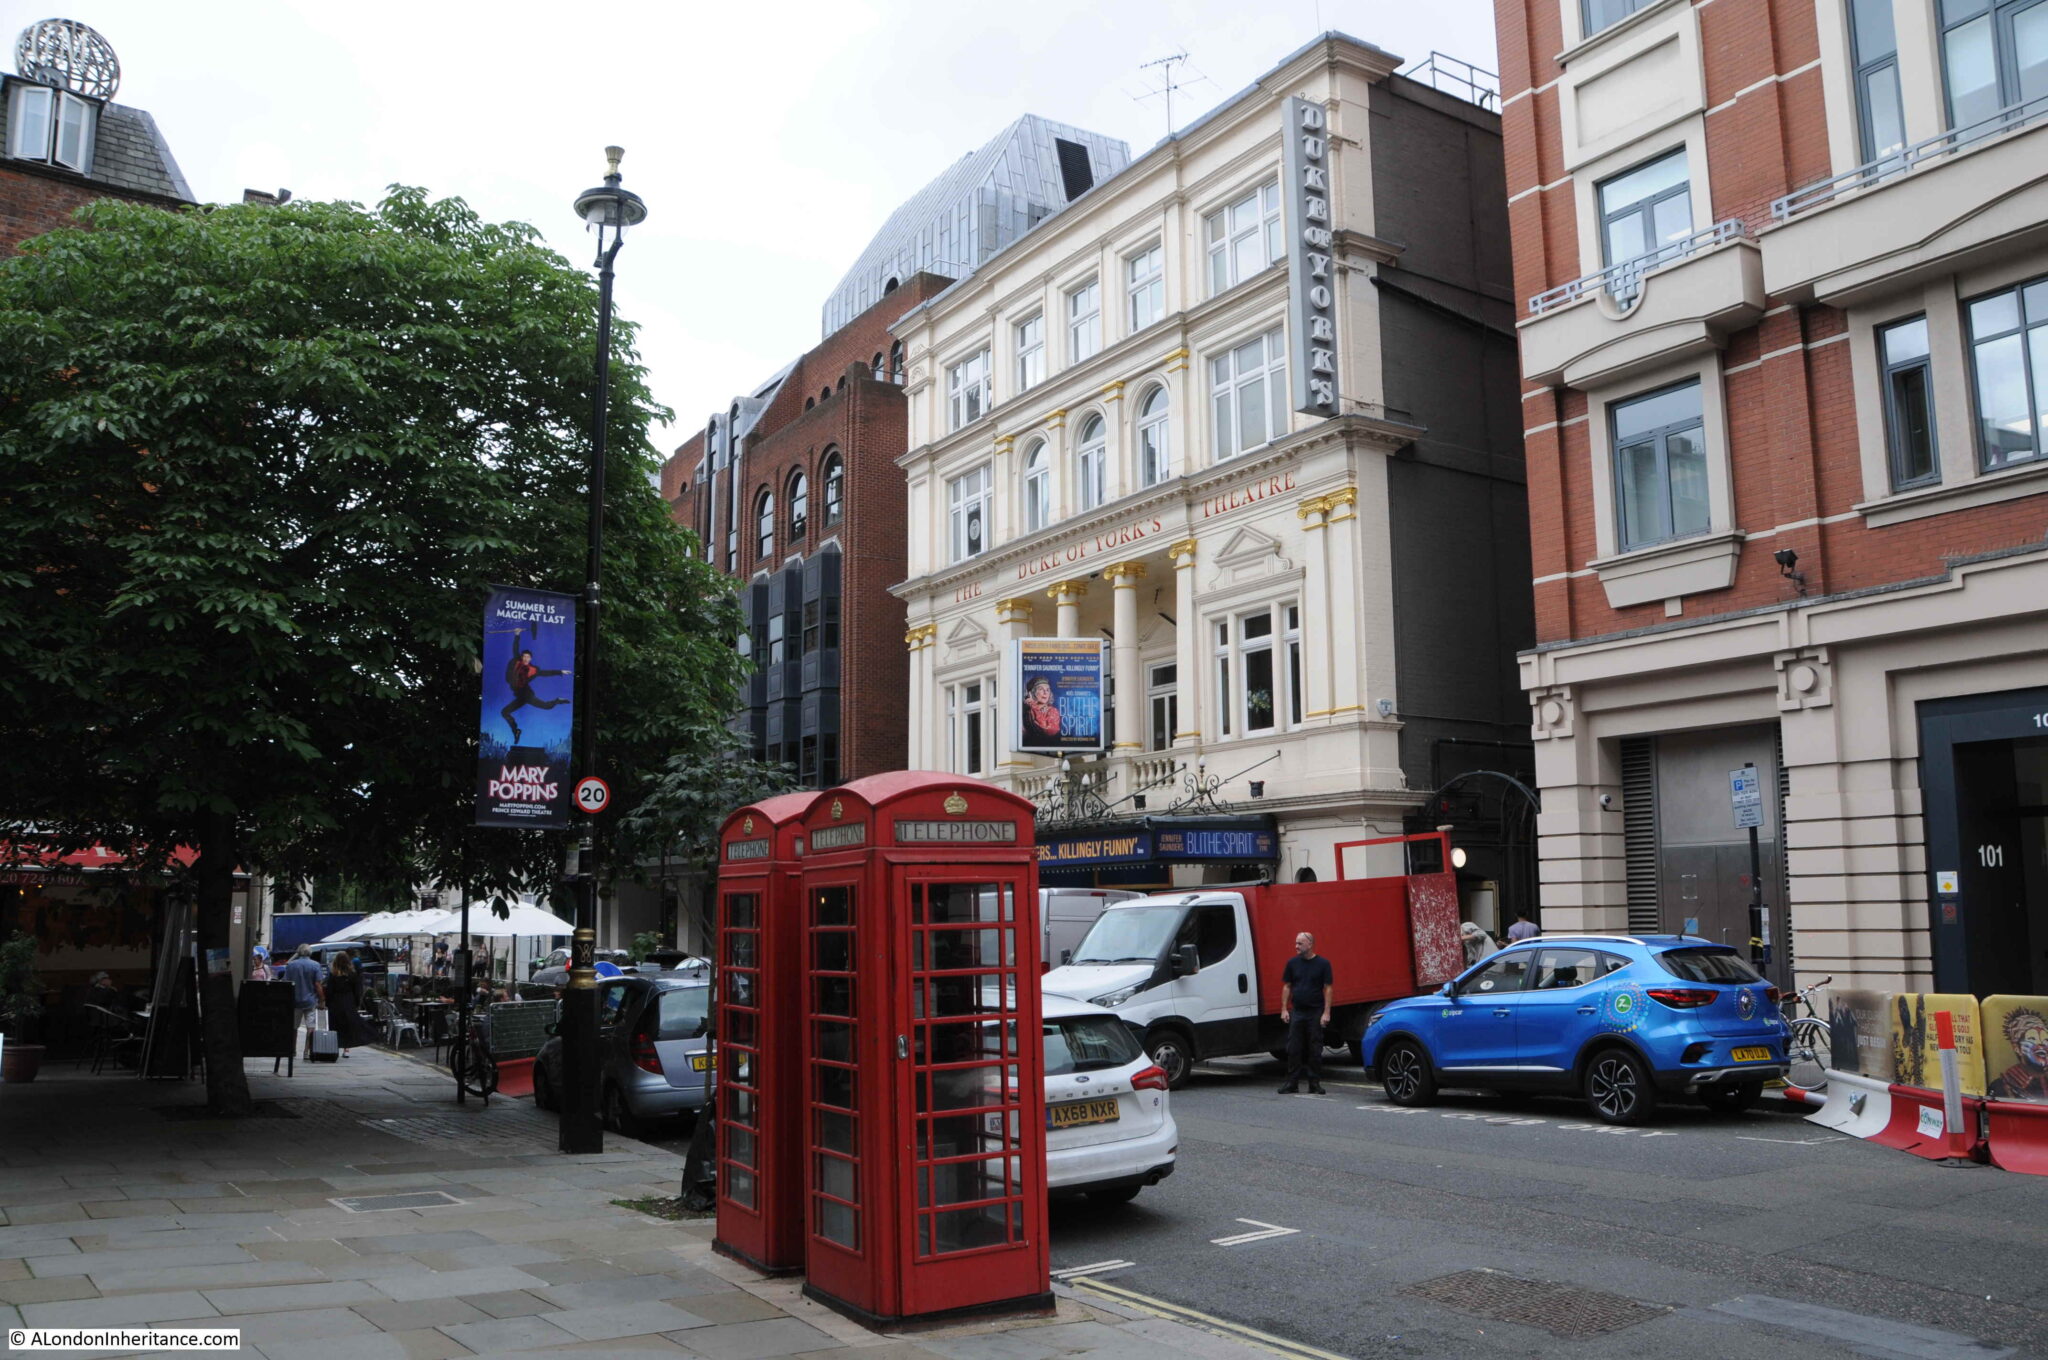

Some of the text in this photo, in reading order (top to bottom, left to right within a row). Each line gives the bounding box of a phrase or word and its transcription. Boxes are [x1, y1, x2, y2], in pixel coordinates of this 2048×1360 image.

[1301, 104, 1334, 407] DUKE OF YORK'S
[954, 470, 1296, 604] THE DUKE OF YORK'S THEATRE
[497, 609, 565, 624] MAGIC AT LAST
[505, 600, 555, 614] SUMMER IS
[1059, 696, 1099, 718] BLITHE
[1061, 717, 1094, 736] SPIRIT
[501, 765, 550, 783] MARY
[489, 780, 558, 801] POPPINS
[581, 788, 605, 802] 20
[814, 823, 865, 849] TELEPHONE
[902, 821, 1011, 841] TELEPHONE
[728, 839, 769, 860] TELEPHONE
[1058, 841, 1101, 859] KILLINGLY
[1103, 837, 1138, 856] FUNNY'
[1187, 832, 1222, 854] BLITHE
[1223, 832, 1254, 854] SPIRIT
[1978, 844, 2003, 867] 101
[1055, 1102, 1115, 1123] AX68 NXR
